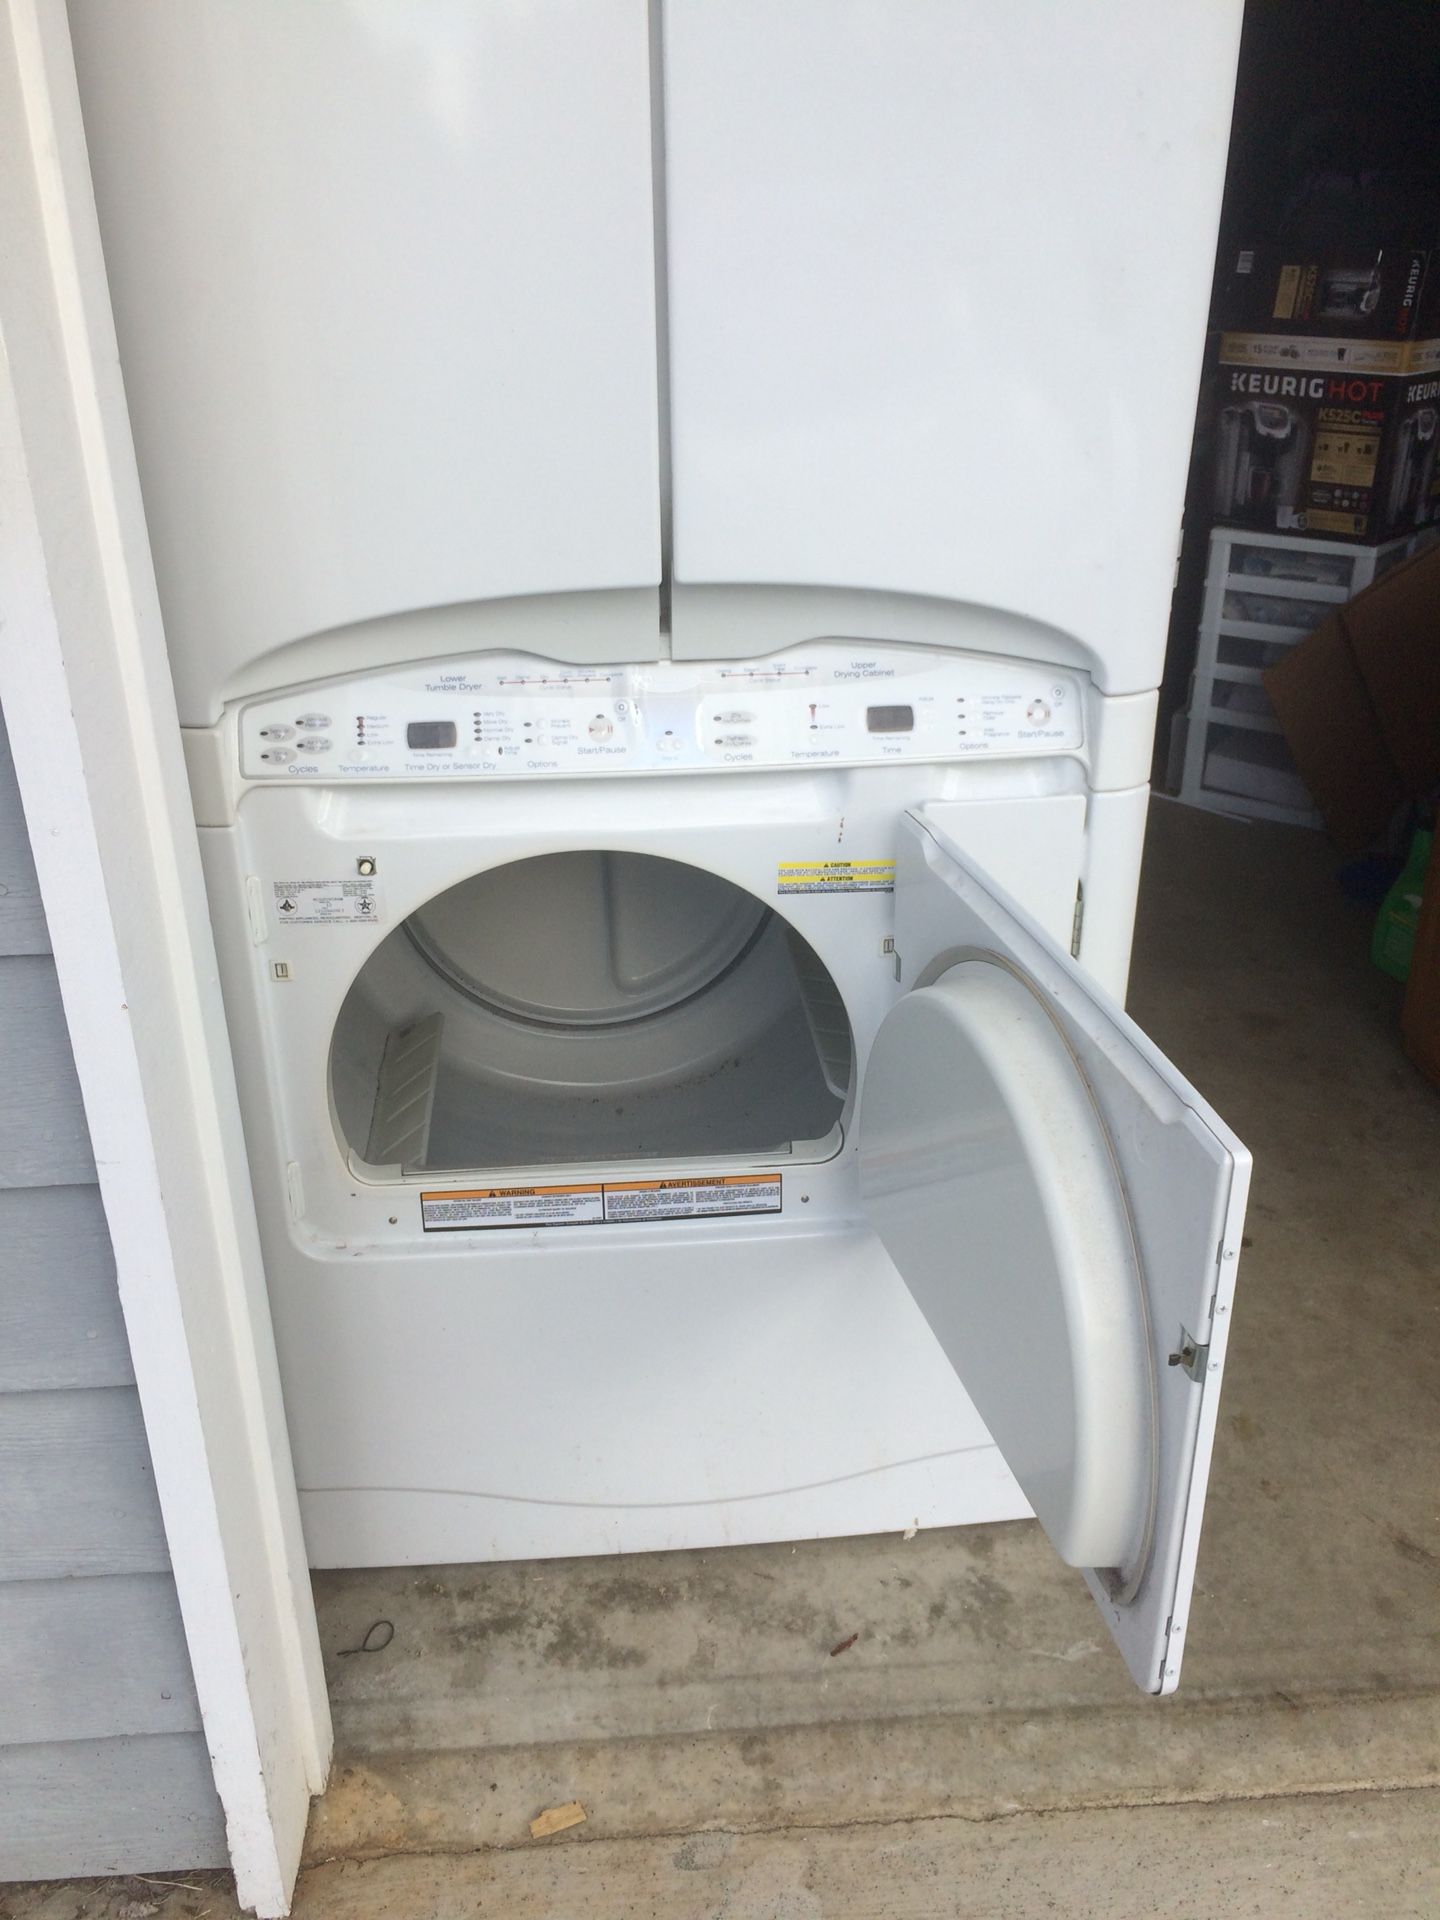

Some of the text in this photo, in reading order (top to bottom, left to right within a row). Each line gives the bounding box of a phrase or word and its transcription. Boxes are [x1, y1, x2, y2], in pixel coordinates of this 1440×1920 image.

[1231, 372, 1385, 402] KEURIG HOT
[851, 662, 876, 670] Upper
[834, 668, 895, 678] Drying Cabinet
[440, 675, 467, 683] Lower
[425, 682, 482, 692] Tumble Dryer
[960, 743, 988, 751] Options
[724, 753, 753, 762] Cycles
[791, 750, 840, 759] Temperature
[338, 764, 390, 774] Temperature
[405, 763, 424, 771] Time
[427, 763, 440, 772] Dry
[453, 762, 480, 770] Sensor
[482, 762, 497, 771] Dry
[527, 760, 558, 769] Options
[288, 765, 319, 775] Cycles
[667, 1178, 726, 1188] AVERTISSEMENT
[500, 1188, 536, 1196] WARNING
